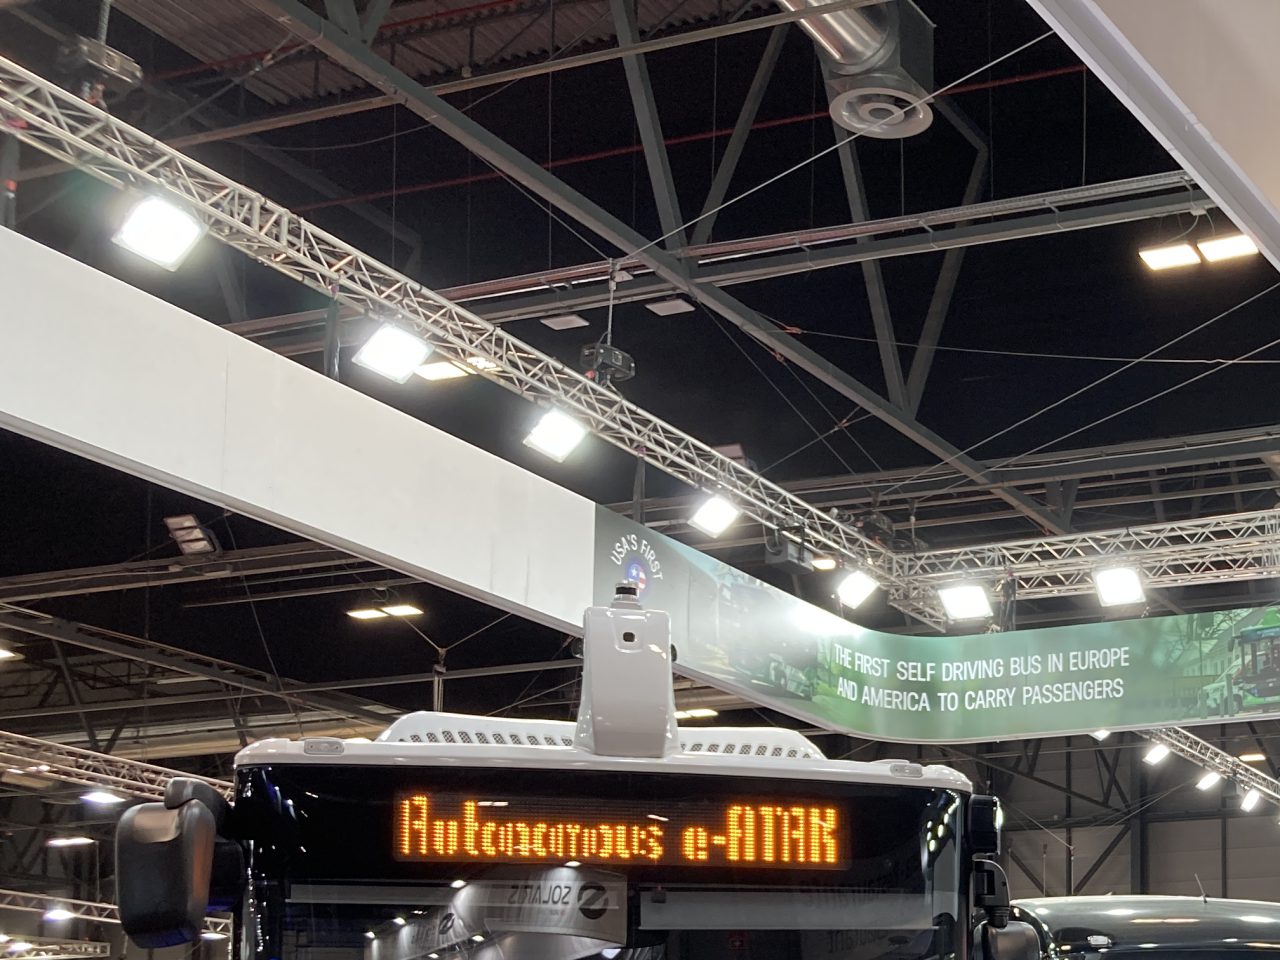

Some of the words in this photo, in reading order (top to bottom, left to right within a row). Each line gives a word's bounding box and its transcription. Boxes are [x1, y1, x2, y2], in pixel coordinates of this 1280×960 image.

[610, 534, 638, 565] USA'S
[640, 539, 664, 580] FIRST
[834, 643, 852, 667] THE
[854, 652, 890, 678] FIRST
[896, 660, 936, 682] SELF
[942, 658, 1003, 682] DRIVING
[1010, 655, 1042, 676] BUS
[1048, 652, 1064, 673] IN
[1069, 646, 1130, 672] EUROPE
[836, 676, 858, 702] AND
[861, 686, 931, 712] AMERICA
[937, 692, 959, 712] TO
[964, 688, 1016, 710] CARRY
[1022, 678, 1124, 706] PASSENGERS
[400, 795, 664, 860] Autonomous
[681, 805, 839, 864] e-ATAK
